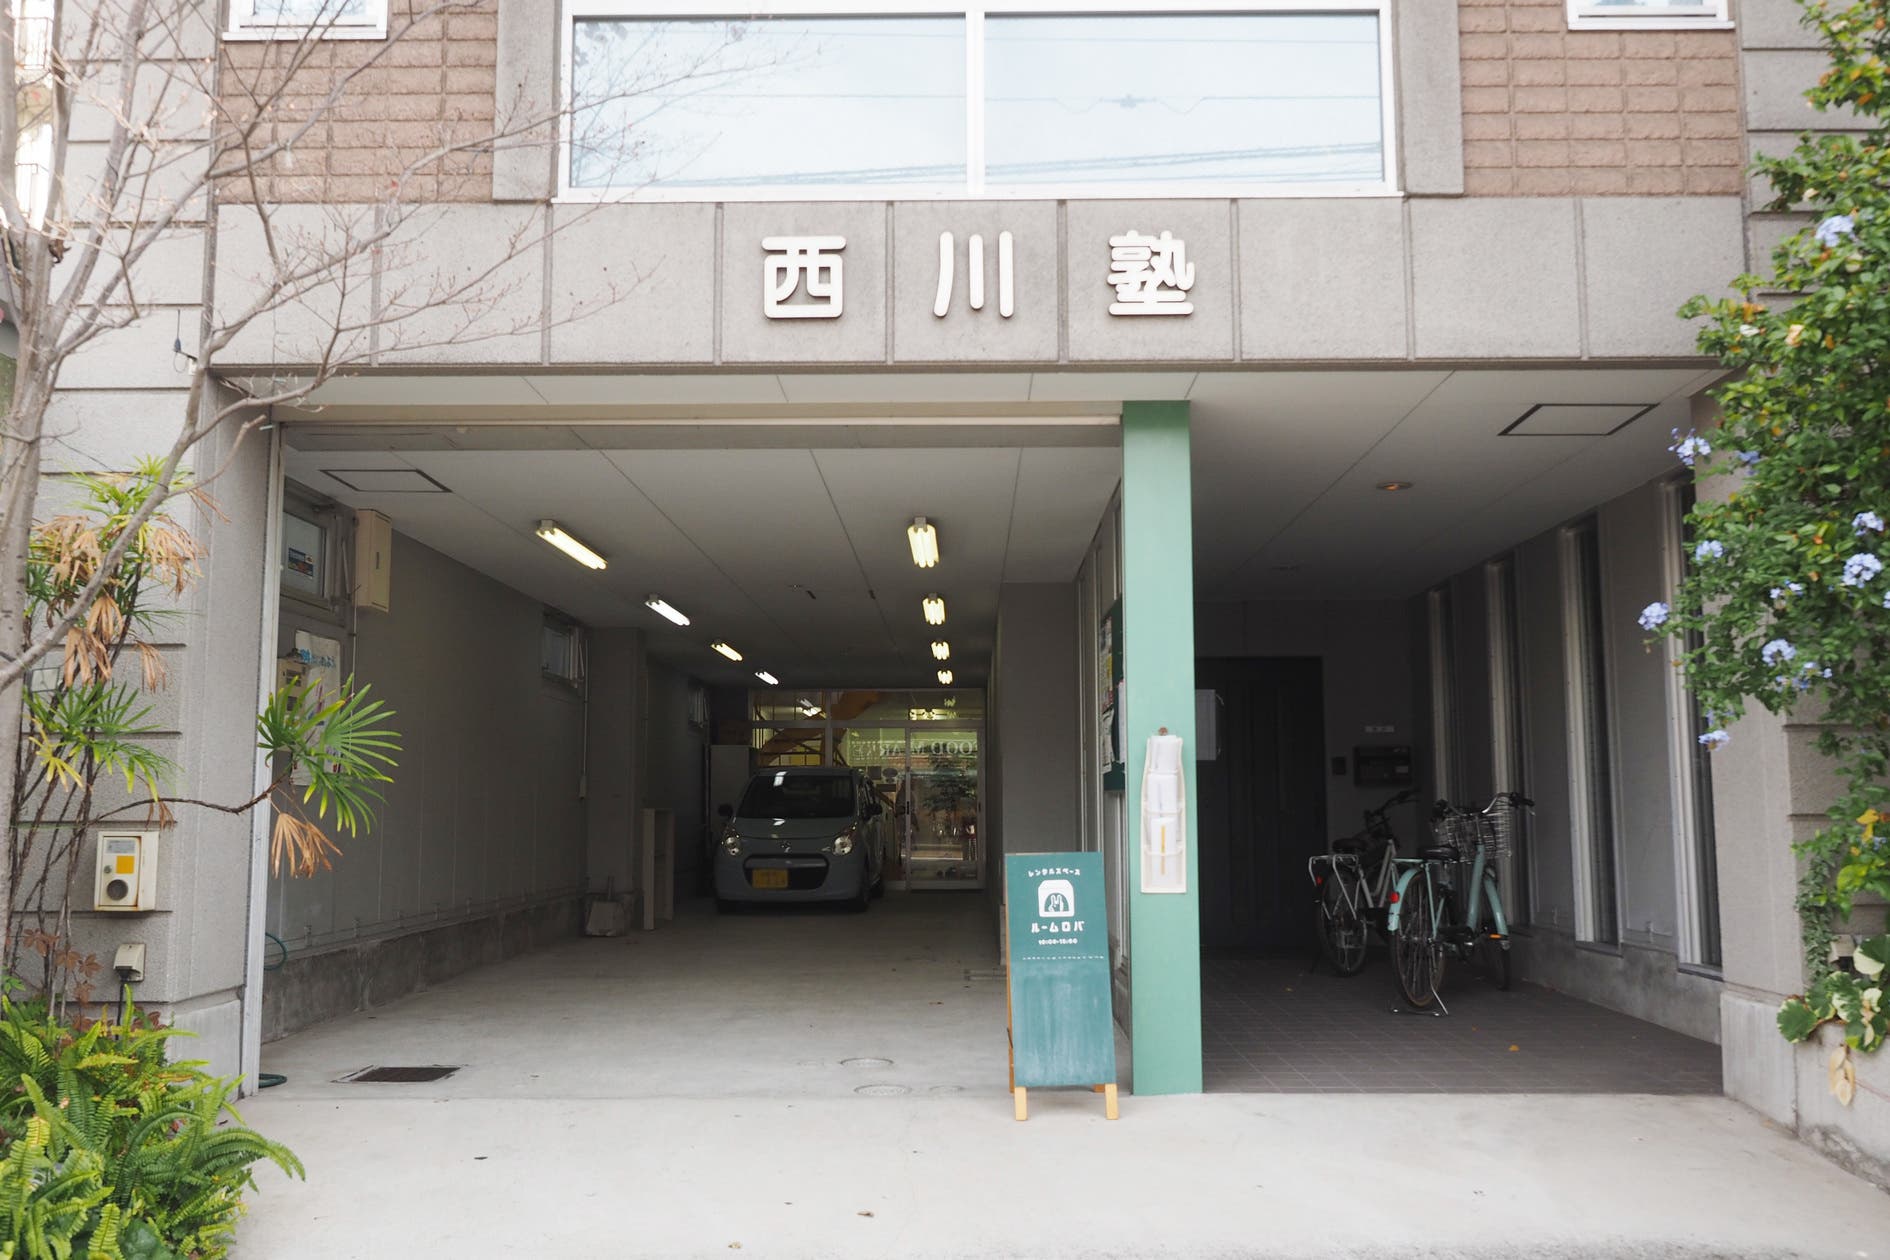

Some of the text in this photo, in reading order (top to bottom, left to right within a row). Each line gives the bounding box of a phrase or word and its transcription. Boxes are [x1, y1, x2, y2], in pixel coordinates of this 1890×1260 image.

[761, 230, 1196, 319] 西川塾
[1031, 920, 1085, 933] ルームロバ
